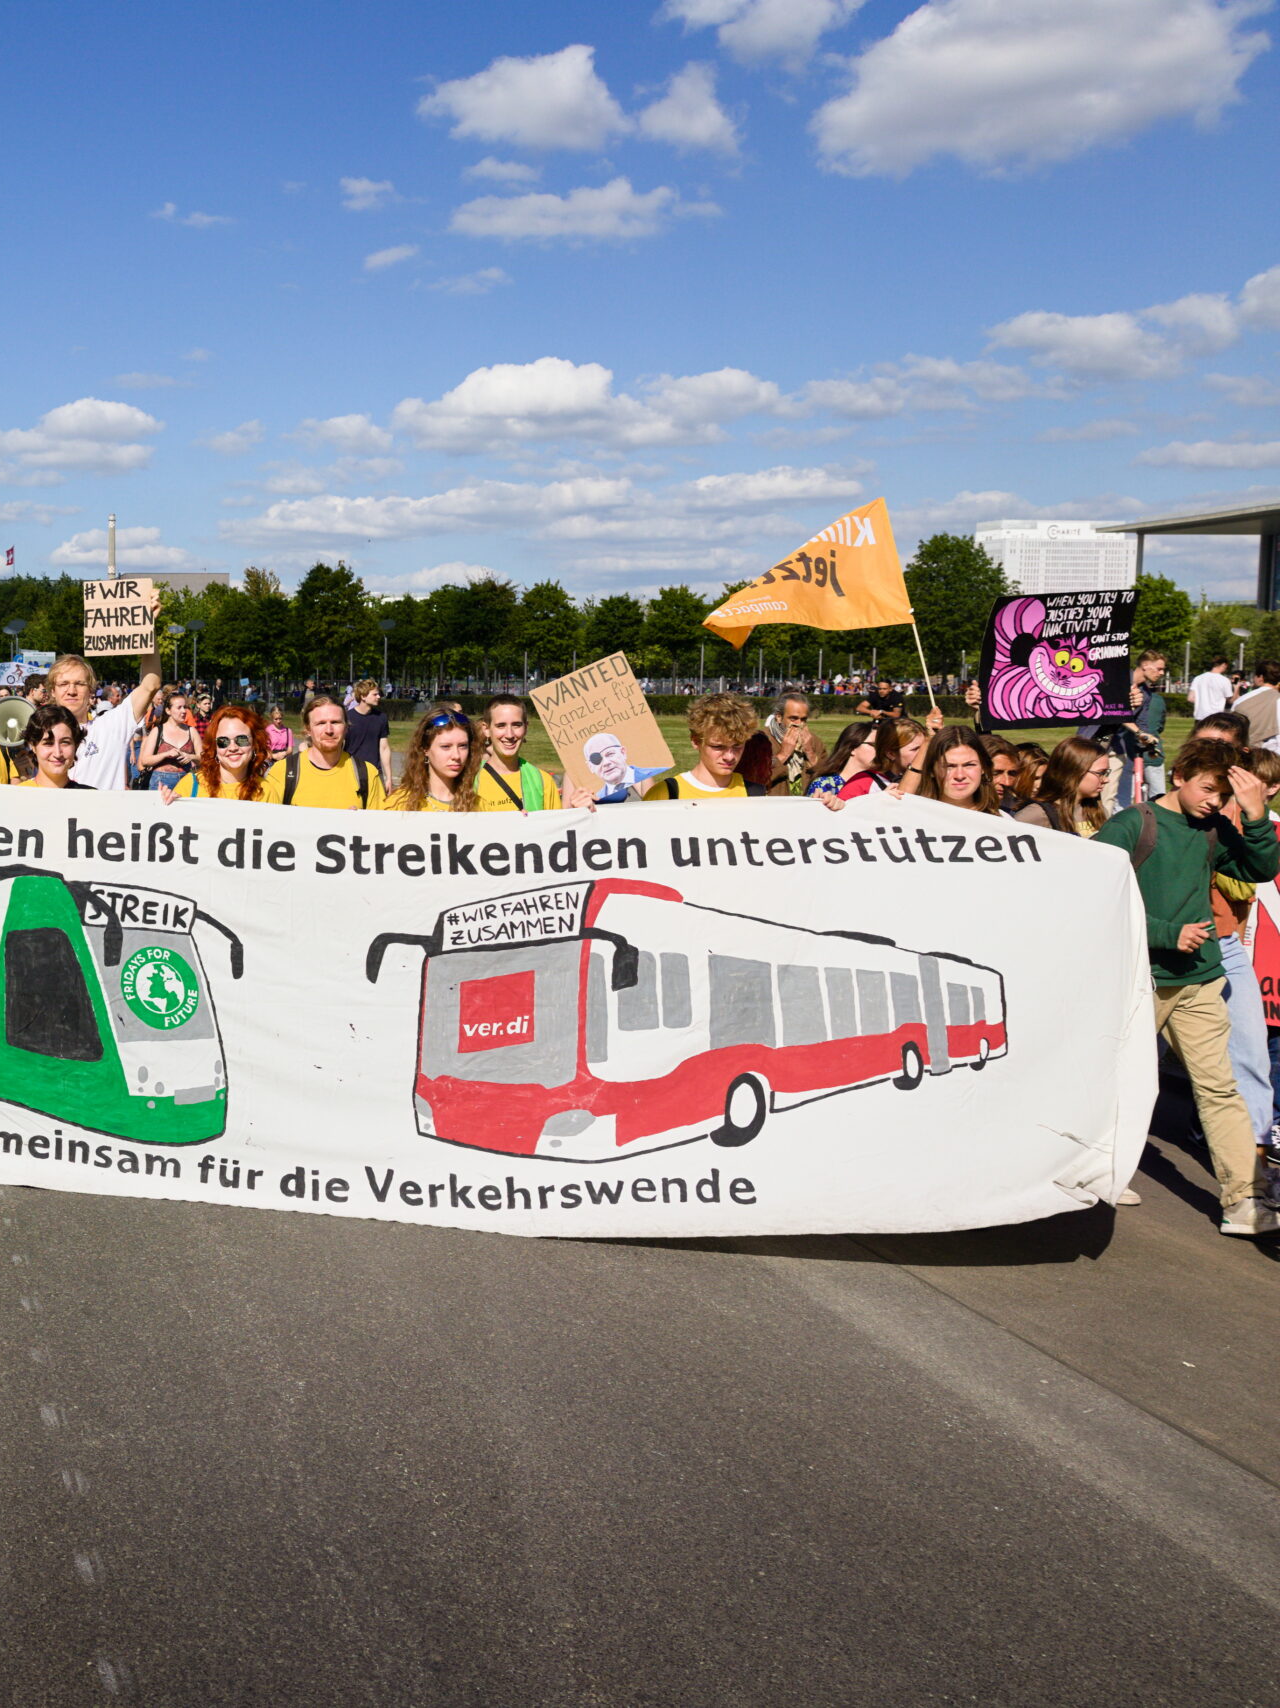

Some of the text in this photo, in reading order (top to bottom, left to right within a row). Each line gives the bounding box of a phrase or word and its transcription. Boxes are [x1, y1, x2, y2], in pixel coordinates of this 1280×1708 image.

[1046, 591, 1135, 607] WHEN YOU TRY TO
[84, 605, 154, 628] FAHREN
[1042, 618, 1111, 638] INACTIVITY I
[1045, 606, 1112, 622] JUSTIFY YOUR
[84, 631, 154, 651] ZUSAMMEN!
[1111, 632, 1129, 642] STOP
[1088, 644, 1129, 661] GRINNING
[532, 655, 629, 711] WANTED
[543, 681, 634, 731] Kanzler für
[552, 699, 648, 748] Klimaschutz
[67, 818, 199, 864] heißt
[217, 828, 296, 872] die
[315, 830, 648, 876] Streikenden
[670, 826, 1042, 868] unterstützen
[88, 889, 190, 929] STREIK
[500, 891, 580, 917] FAHREN
[450, 913, 575, 946] ZUSAMMEN
[123, 948, 171, 1001] FRIDAYS FOR
[164, 989, 198, 1027] FUTURE
[462, 1015, 530, 1037] ver.di
[197, 1154, 264, 1190] für
[279, 1166, 351, 1203] die
[364, 1165, 757, 1212] Verkehrswende
